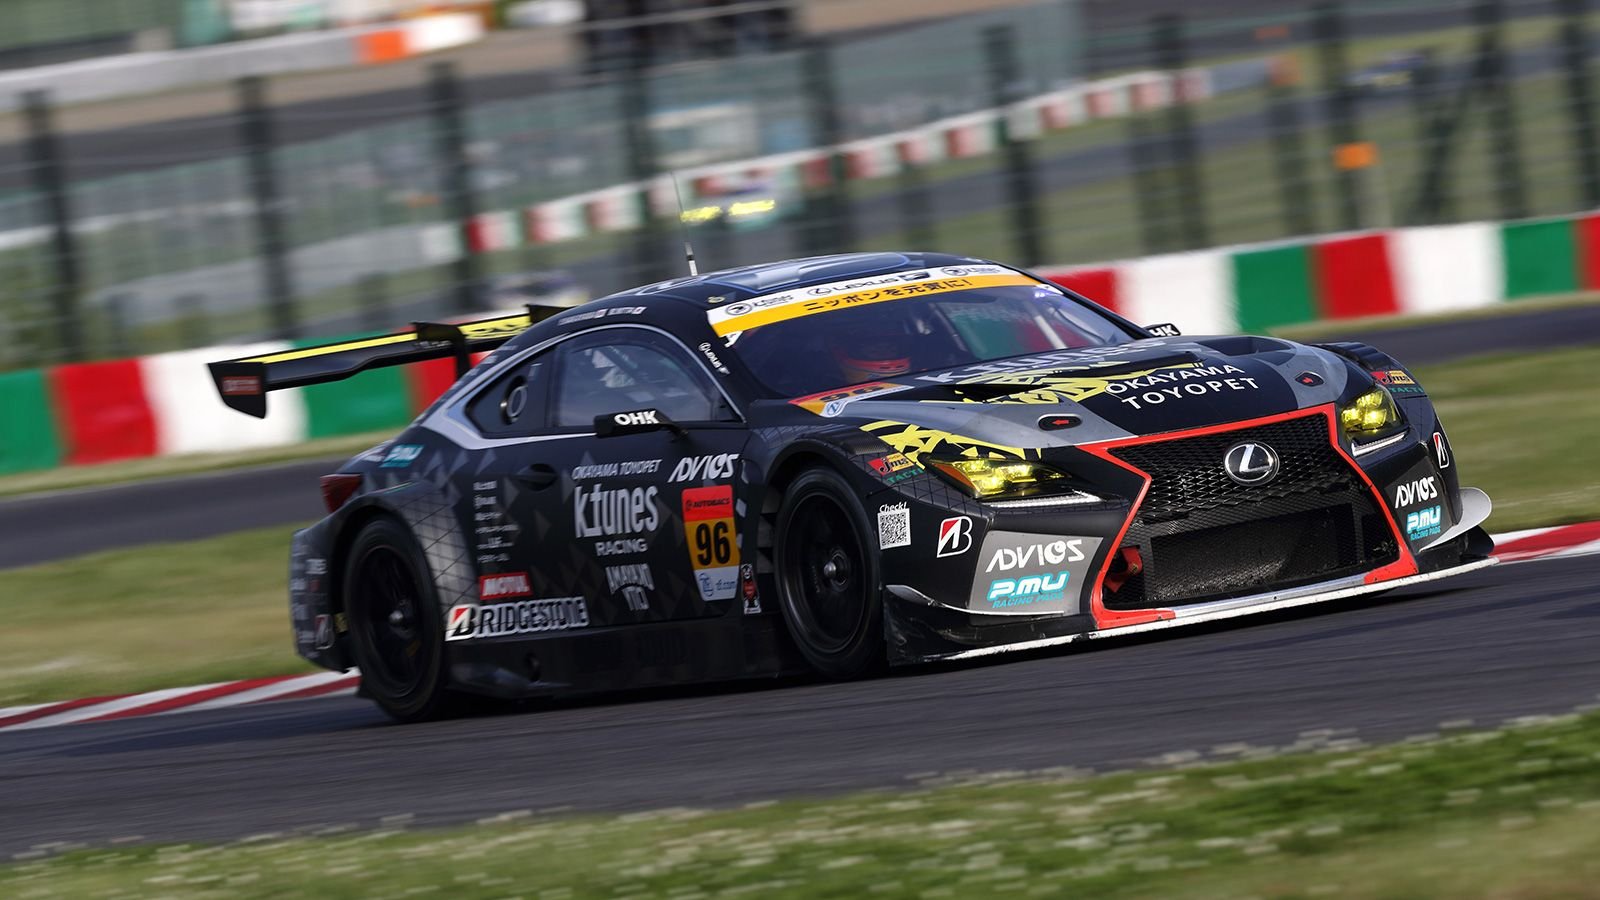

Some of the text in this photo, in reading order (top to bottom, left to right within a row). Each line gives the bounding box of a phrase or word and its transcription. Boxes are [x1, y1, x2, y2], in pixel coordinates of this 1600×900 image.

[833, 276, 899, 291] LEXUS
[1105, 364, 1245, 394] OKAYAMA
[1122, 378, 1259, 410] TOYOPET
[614, 410, 660, 426] OHK
[572, 462, 617, 480] OKAYAMA
[667, 453, 739, 484] ADVICS
[880, 501, 907, 512] Check!
[1394, 476, 1438, 509] ADVICS
[595, 538, 648, 556] RACING
[695, 521, 731, 566] 96
[986, 540, 1085, 573] ADVICS
[991, 595, 1034, 609] RACING
[445, 596, 589, 641] BRIDGESTONE
